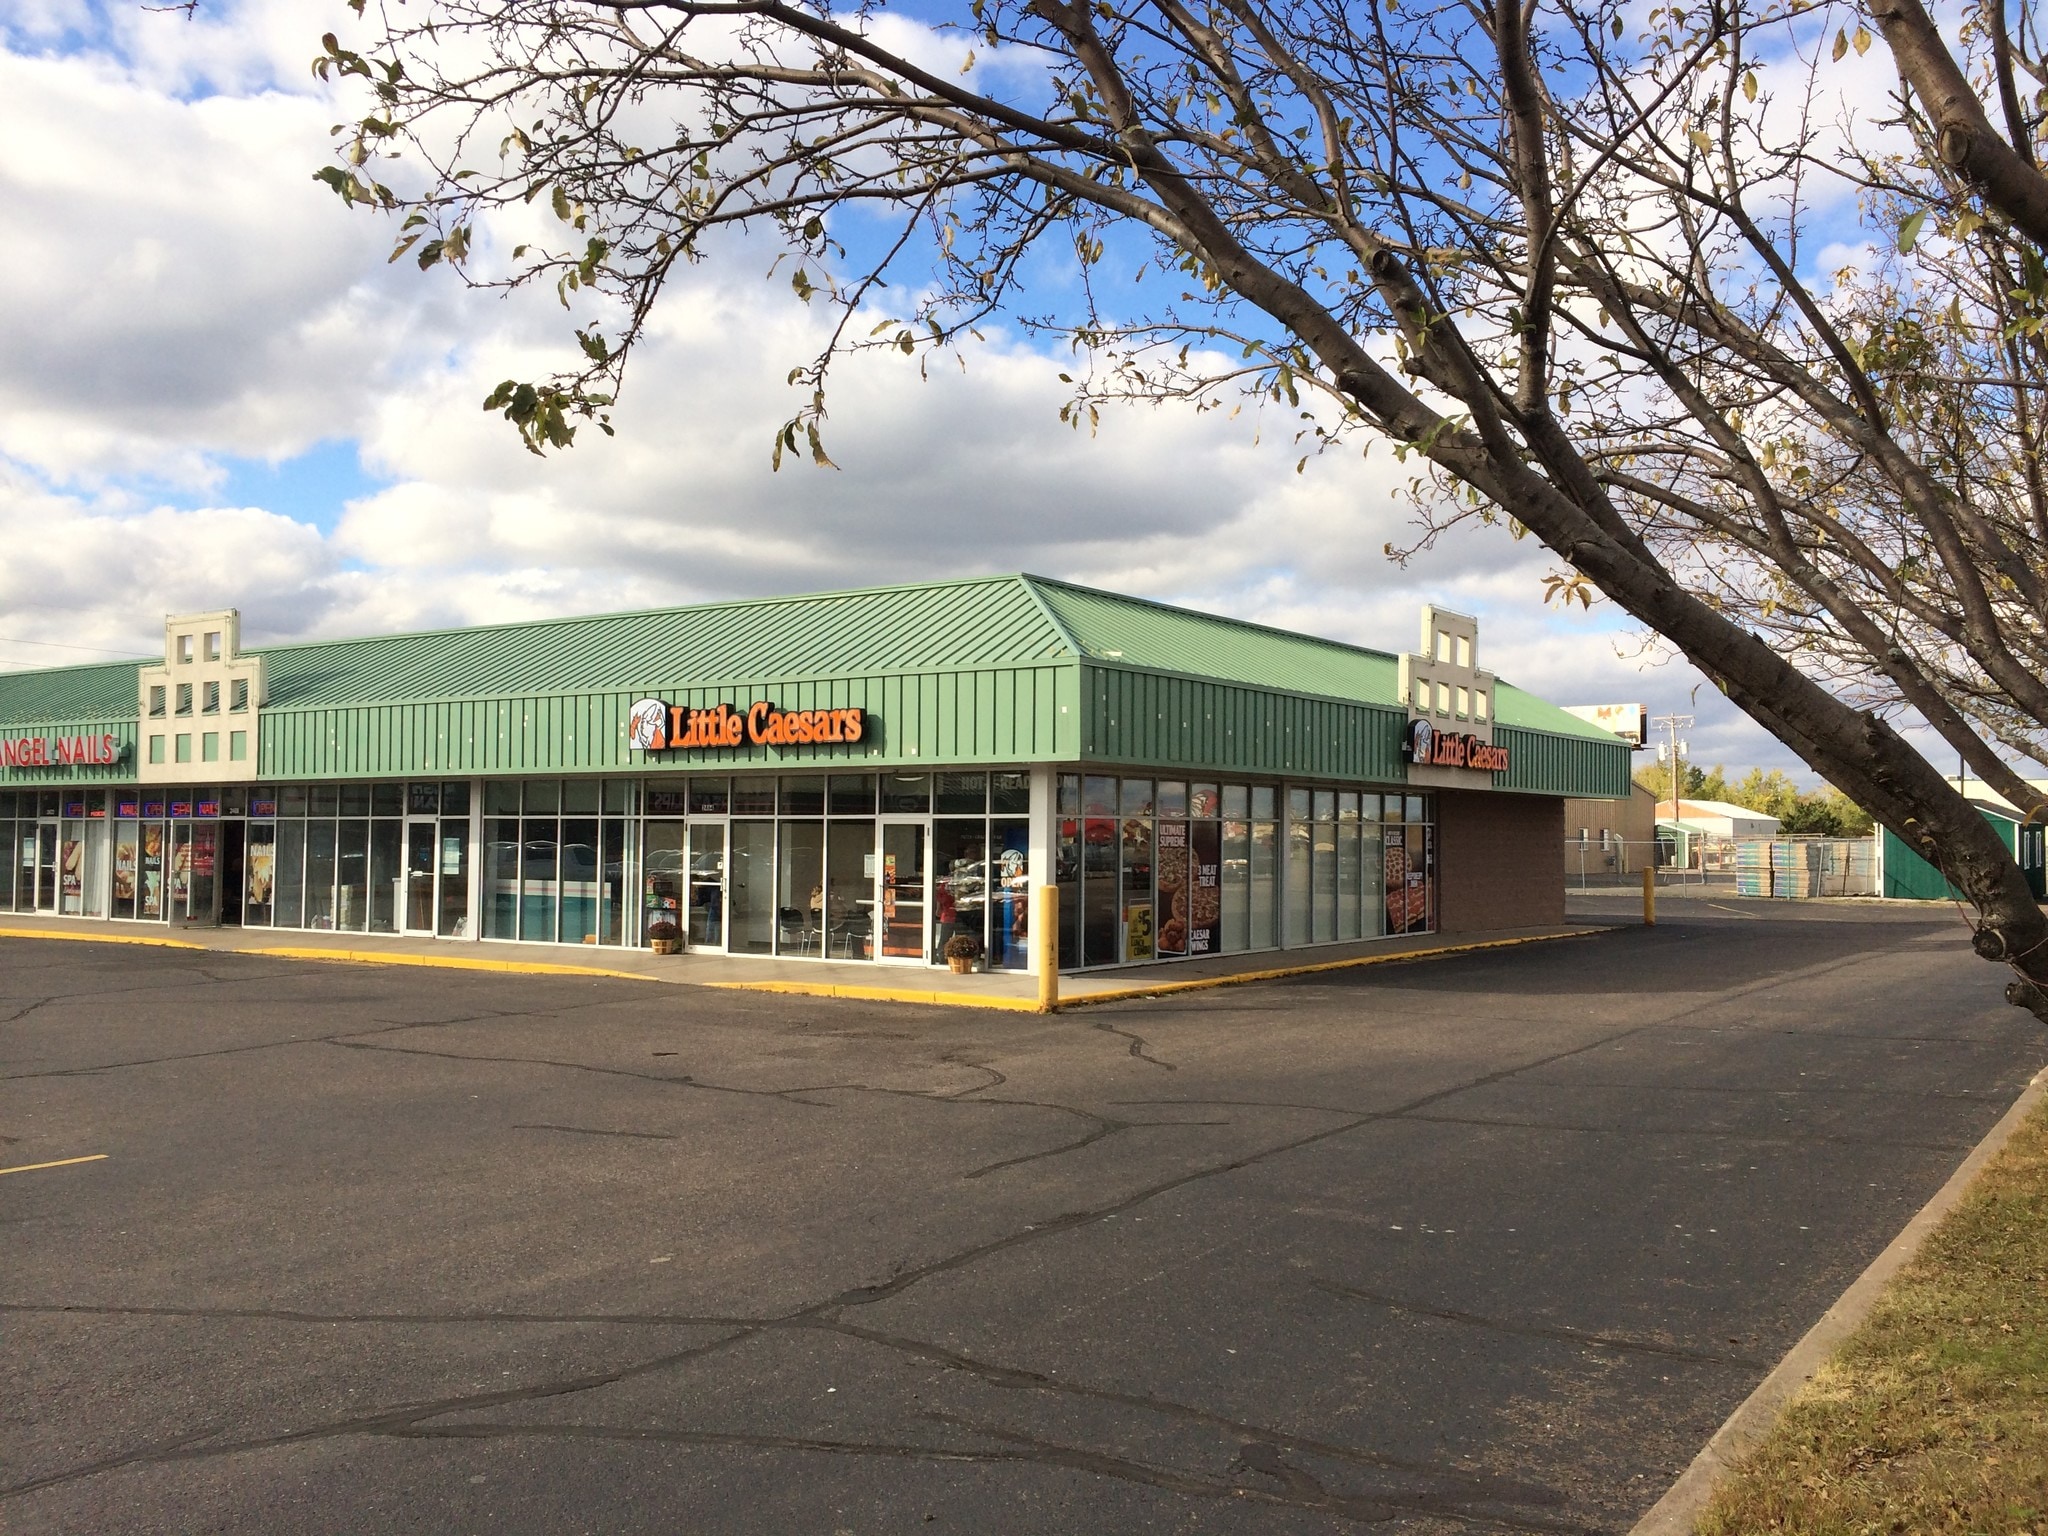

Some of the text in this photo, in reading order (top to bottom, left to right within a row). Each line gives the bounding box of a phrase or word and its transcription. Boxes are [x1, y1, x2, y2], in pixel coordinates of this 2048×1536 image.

[669, 701, 863, 748] Little Caesars
[0, 734, 113, 767] NGEL NAILS
[1432, 730, 1509, 771] Little Caesars
[1160, 824, 1186, 836] ULTIMATE
[1160, 836, 1186, 847] SUPREME
[117, 860, 137, 872] NAILS
[1203, 865, 1217, 876] MEAT
[63, 875, 77, 886] SPA
[1198, 876, 1216, 887] TREAT
